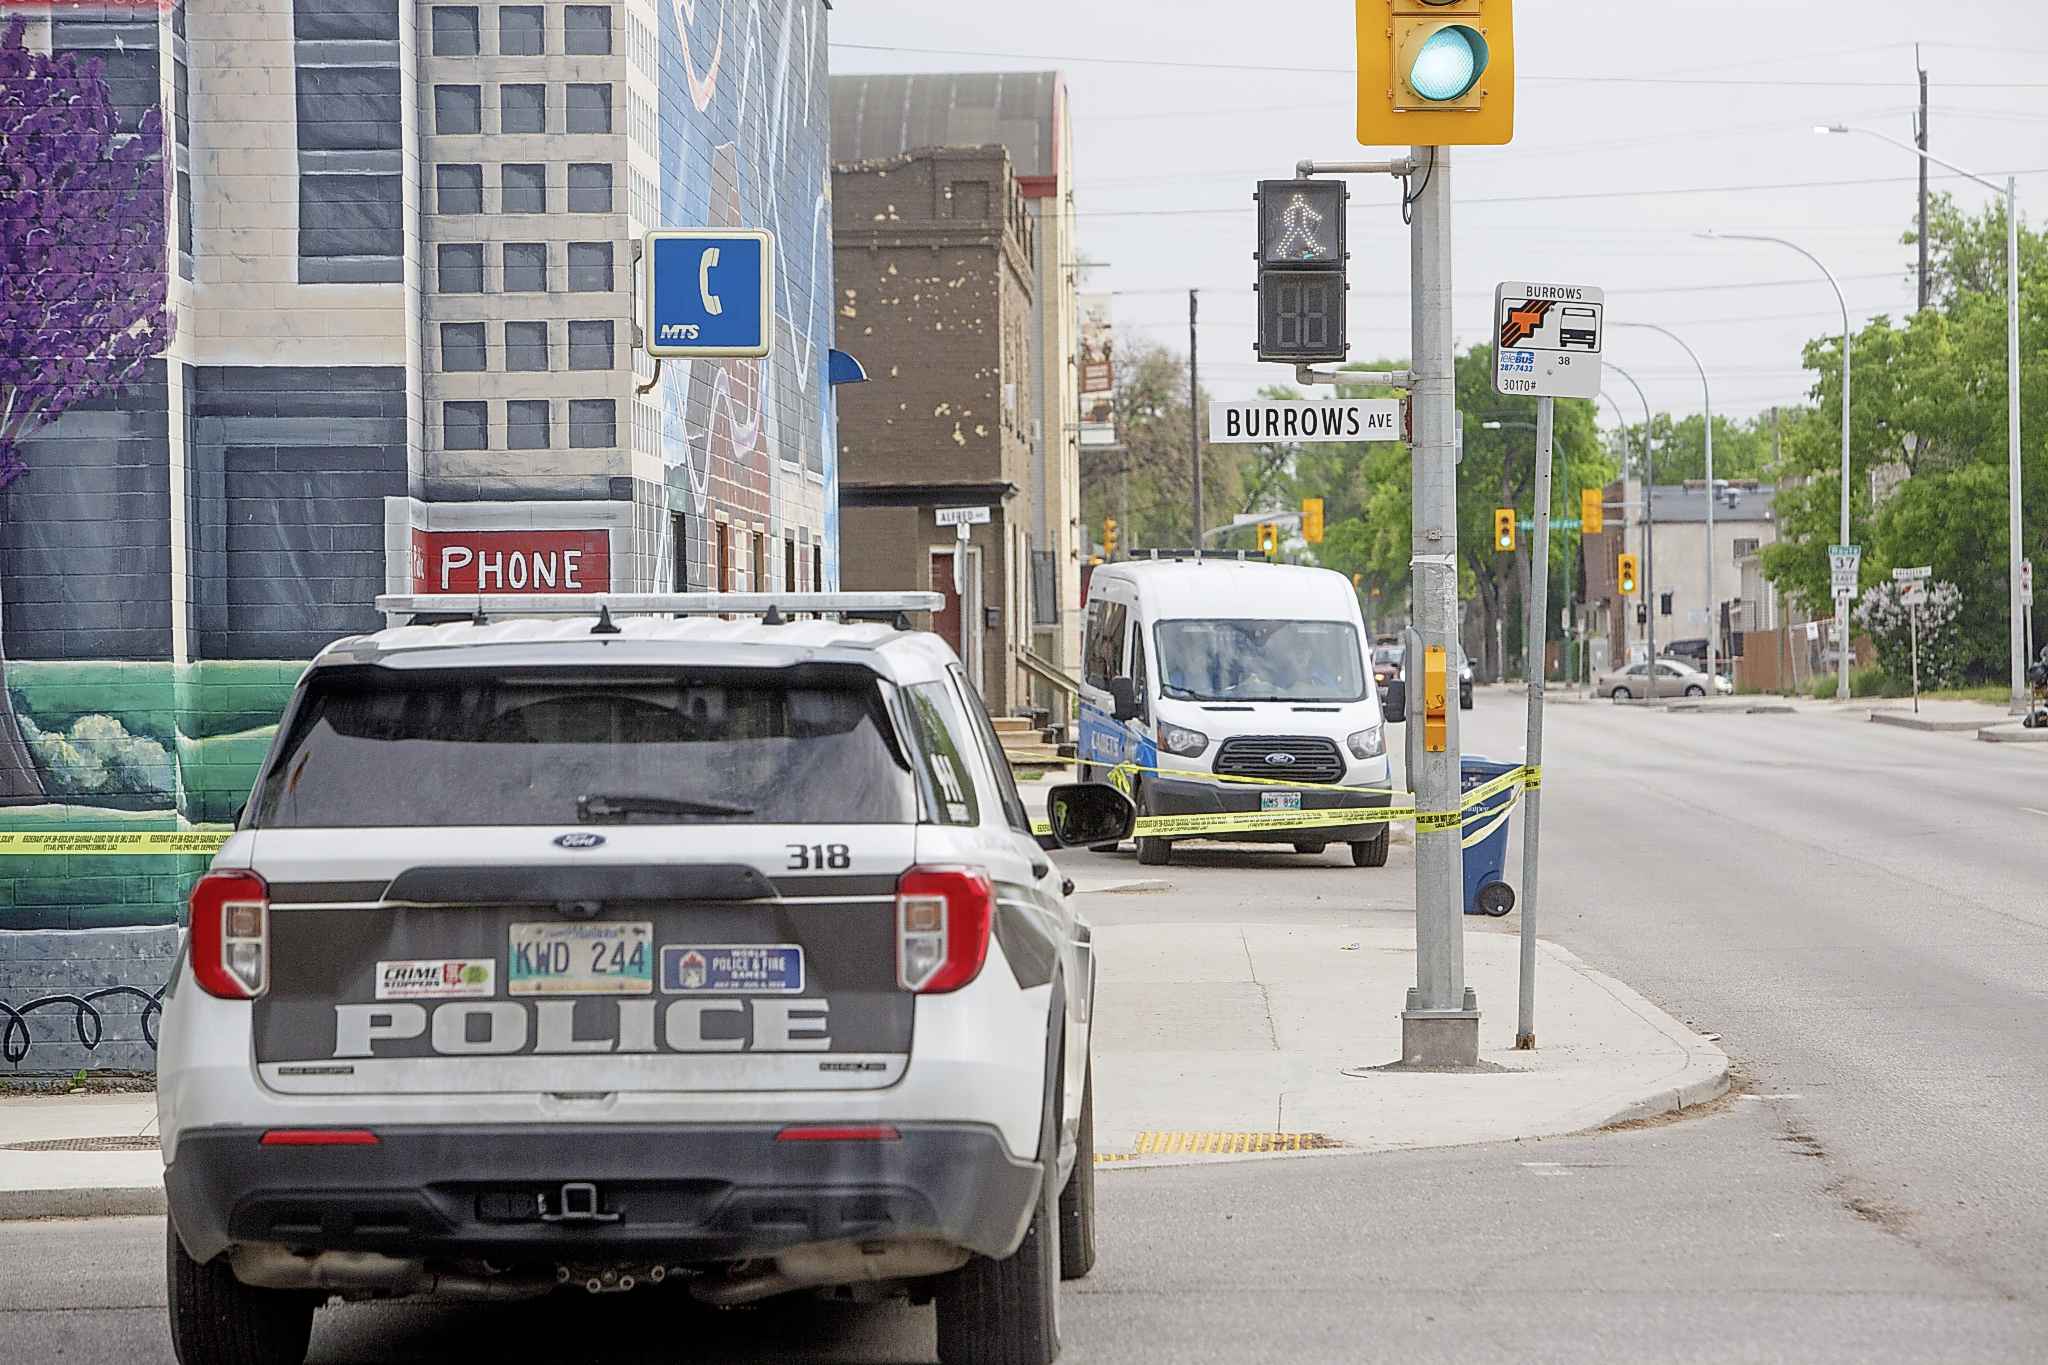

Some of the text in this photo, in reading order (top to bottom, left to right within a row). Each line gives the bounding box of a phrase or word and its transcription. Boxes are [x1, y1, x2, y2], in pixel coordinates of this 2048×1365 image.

[1526, 286, 1582, 299] BURROWS
[660, 324, 700, 339] MTS
[1558, 356, 1570, 366] 38
[1503, 379, 1537, 392] 30170#
[1226, 407, 1392, 437] BURROWS AVE
[441, 546, 583, 590] PHONE
[784, 843, 850, 870] 318
[515, 940, 645, 974] KWD 244
[712, 956, 749, 971] POLICE
[384, 966, 438, 980] CRIME
[333, 998, 831, 1058] POLICE
